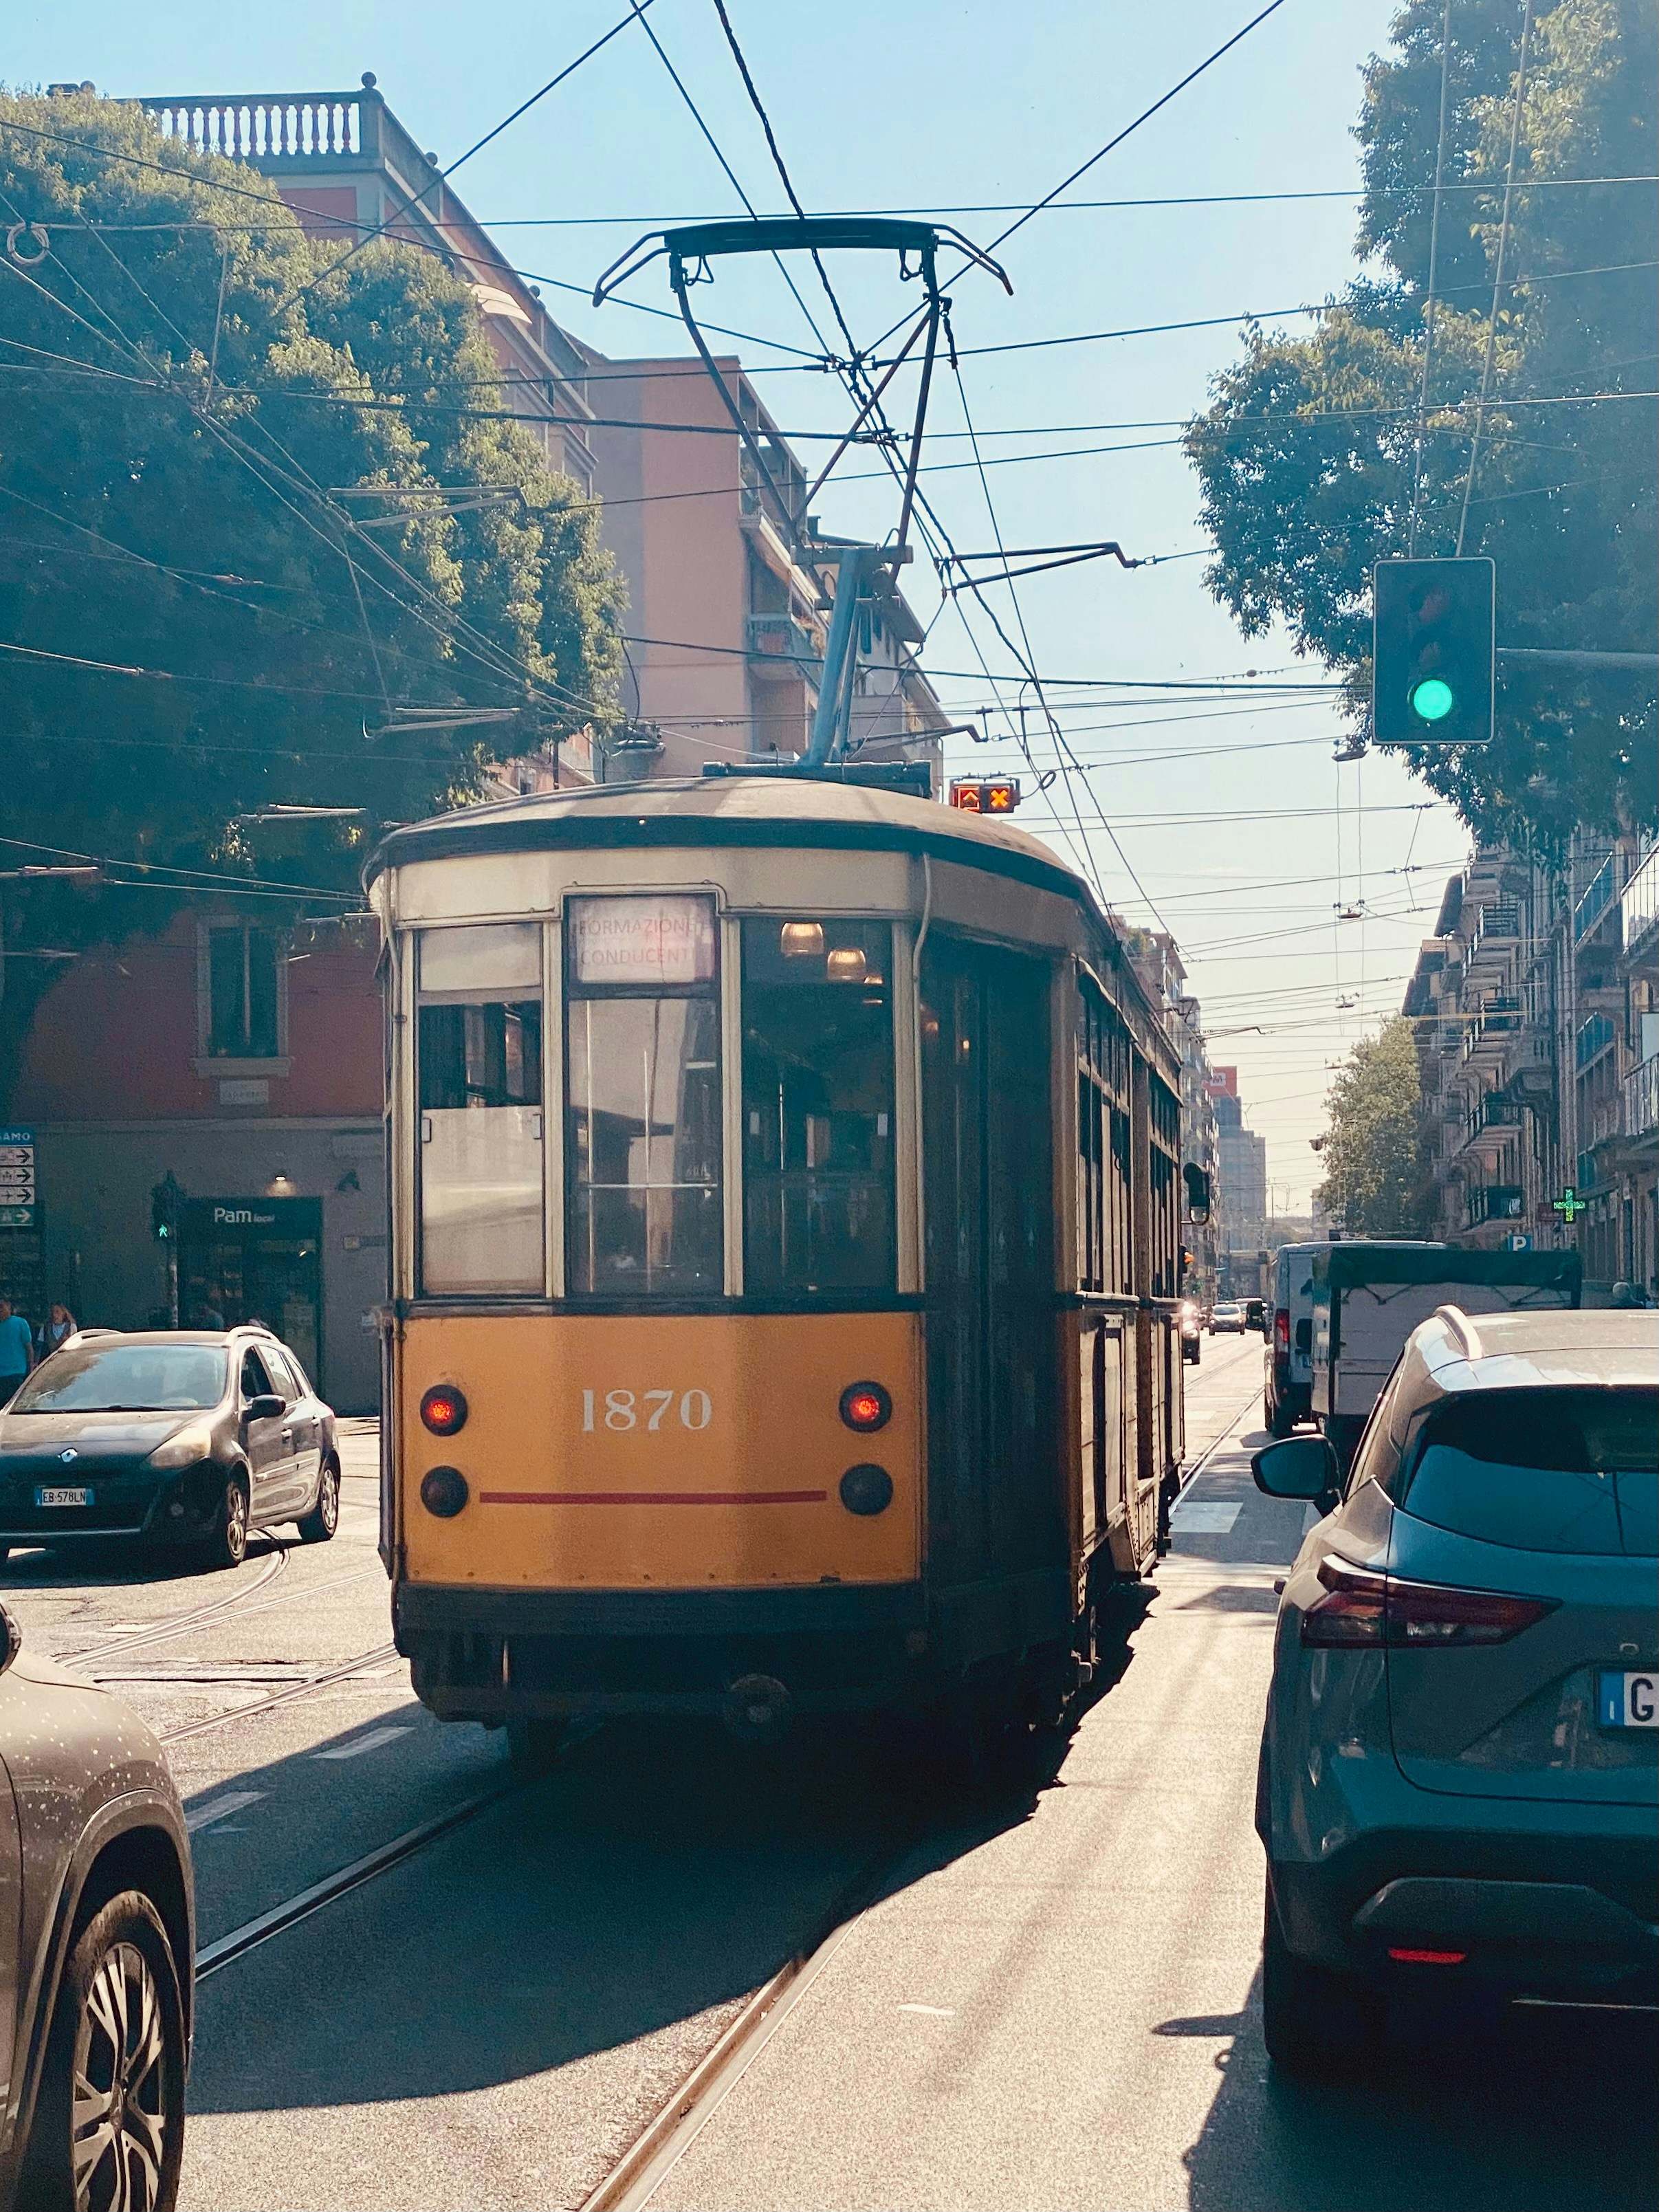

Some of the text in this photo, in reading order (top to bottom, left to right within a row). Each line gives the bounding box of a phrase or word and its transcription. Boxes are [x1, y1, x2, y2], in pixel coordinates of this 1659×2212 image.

[214, 1207, 252, 1223] Pam
[1513, 1236, 1527, 1251] P
[581, 1388, 713, 1432] 1870
[1631, 1677, 1654, 1722] G
